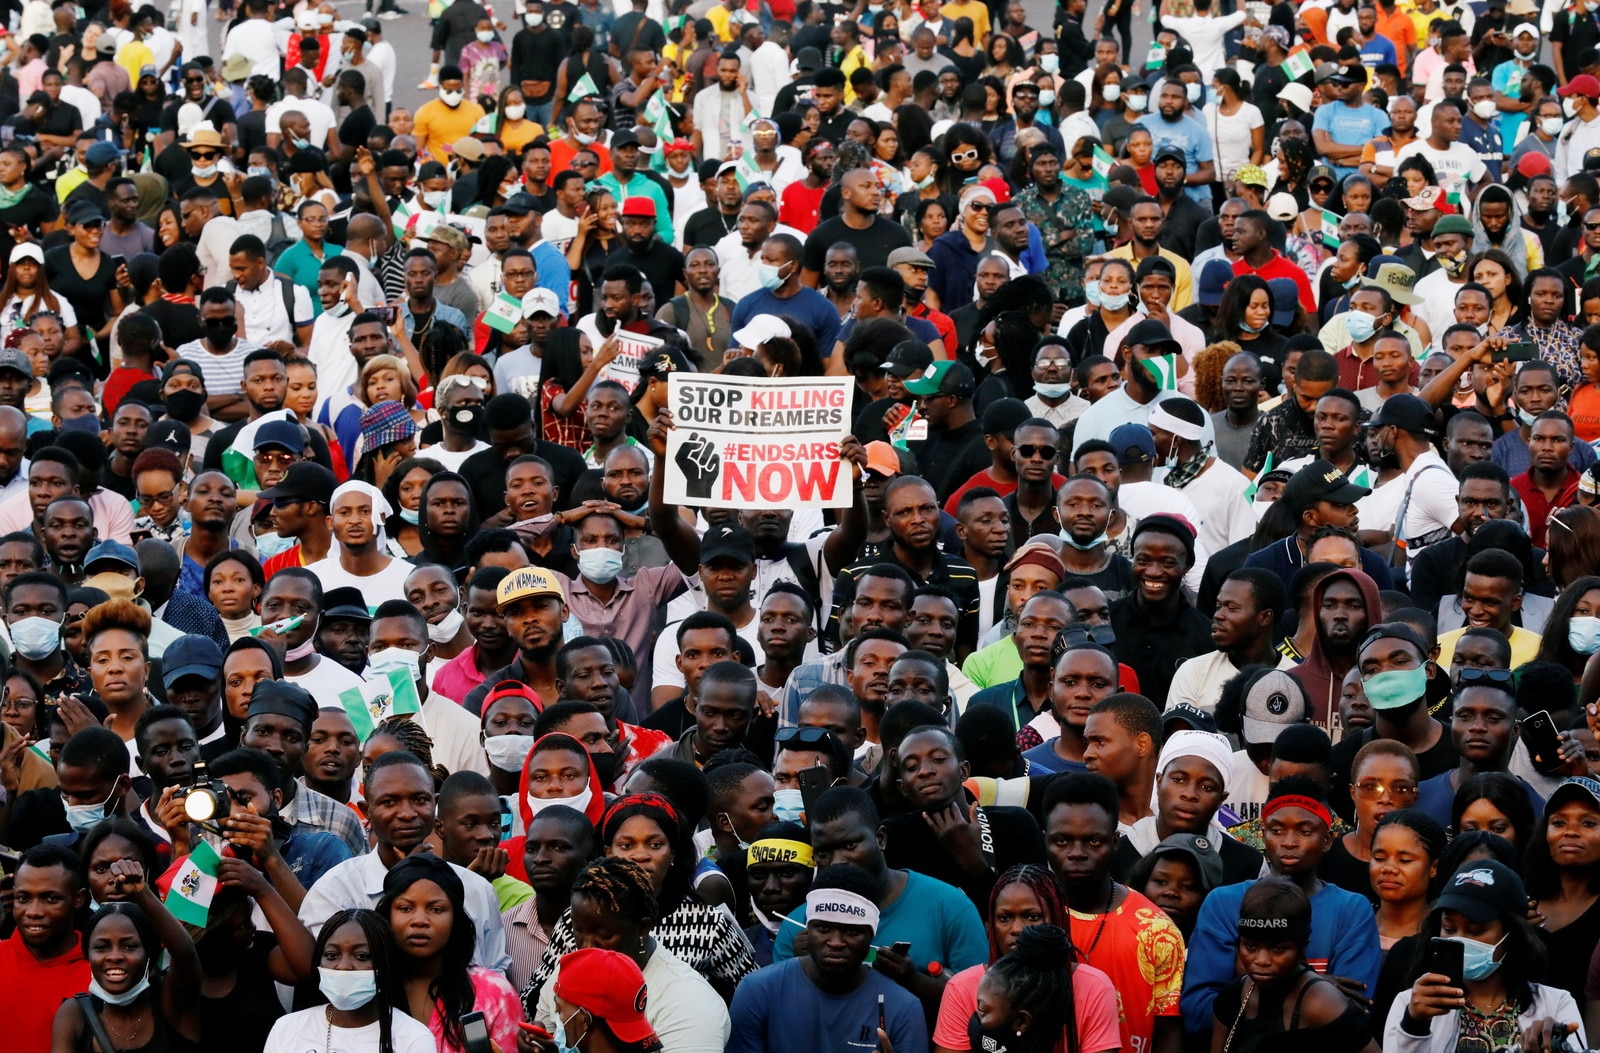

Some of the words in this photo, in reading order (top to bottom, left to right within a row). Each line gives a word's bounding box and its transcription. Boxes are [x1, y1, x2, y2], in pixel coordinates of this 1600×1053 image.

[680, 386, 743, 407] STOP
[751, 389, 844, 410] KILLING
[679, 405, 722, 424] OUR
[729, 408, 841, 426] DREAMERS
[723, 441, 839, 461] #ENDSARS
[722, 460, 840, 501] NOW
[504, 582, 514, 596] AMY
[515, 572, 547, 589] WAMAMA
[815, 902, 866, 917] #ENDSARS
